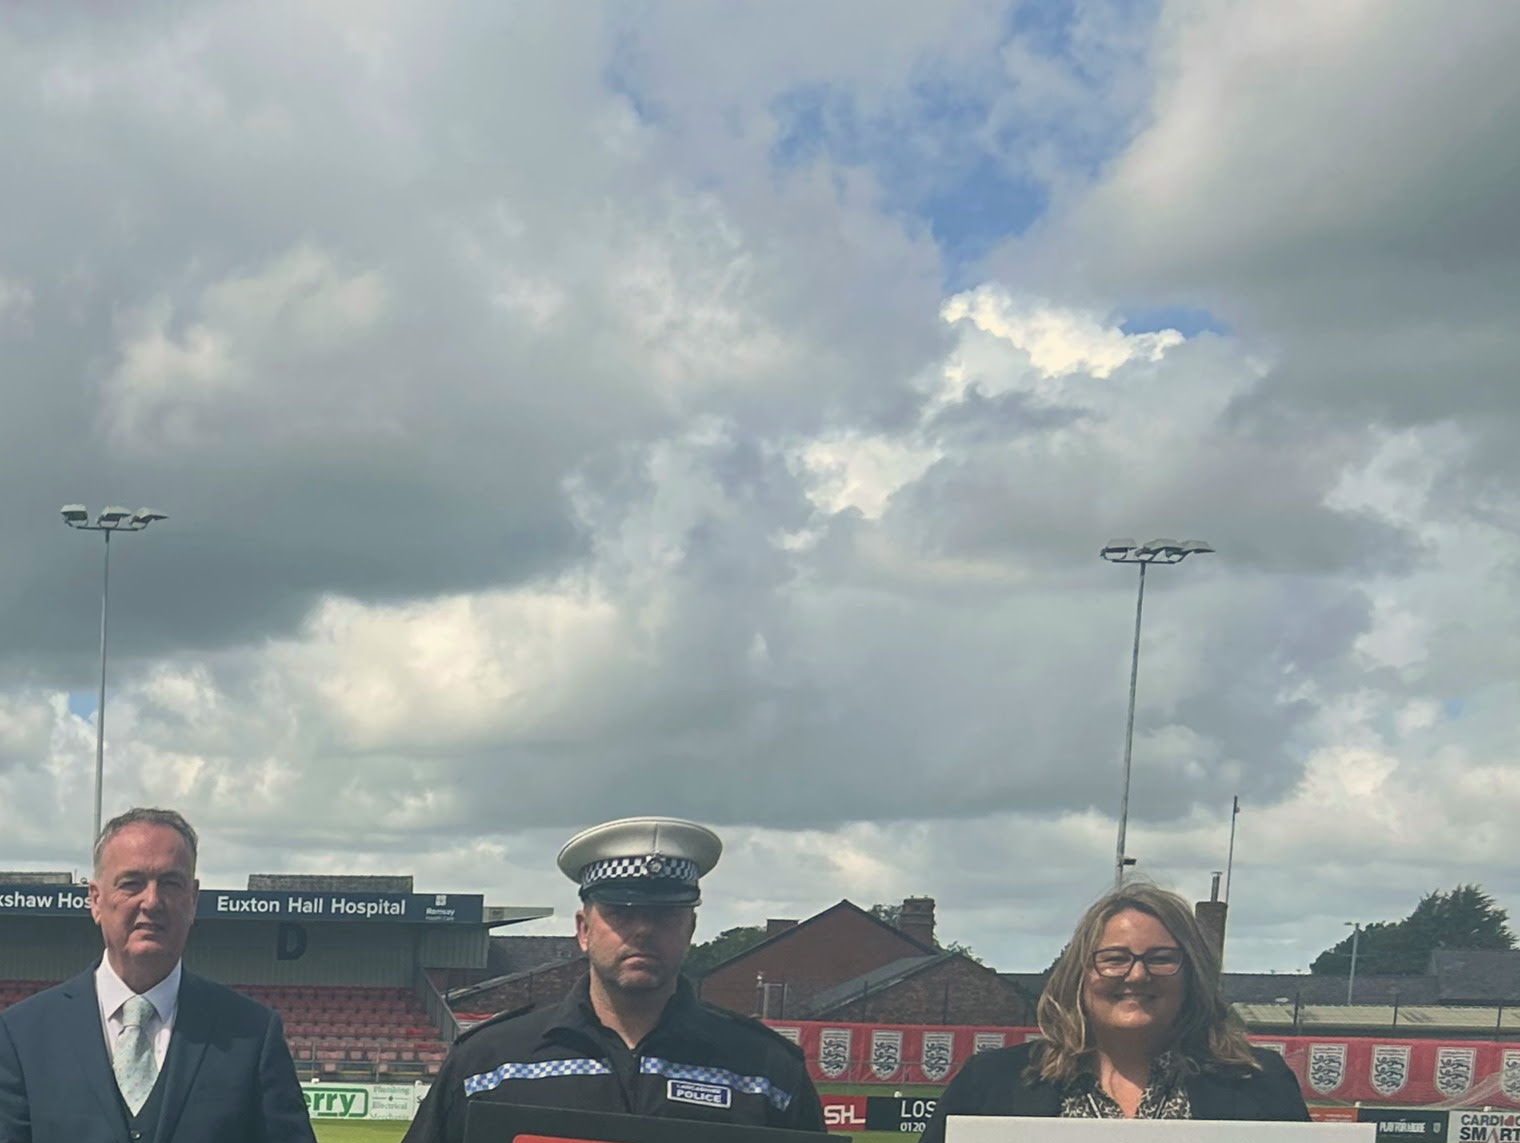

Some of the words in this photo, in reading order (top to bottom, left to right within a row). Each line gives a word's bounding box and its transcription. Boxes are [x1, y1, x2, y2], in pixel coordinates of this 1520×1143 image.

[217, 896, 280, 913] Euxton
[289, 898, 323, 913] Hall
[332, 898, 405, 917] Hospital
[426, 908, 455, 917] Ramsay
[277, 922, 307, 960] D
[677, 1089, 722, 1103] POLICE
